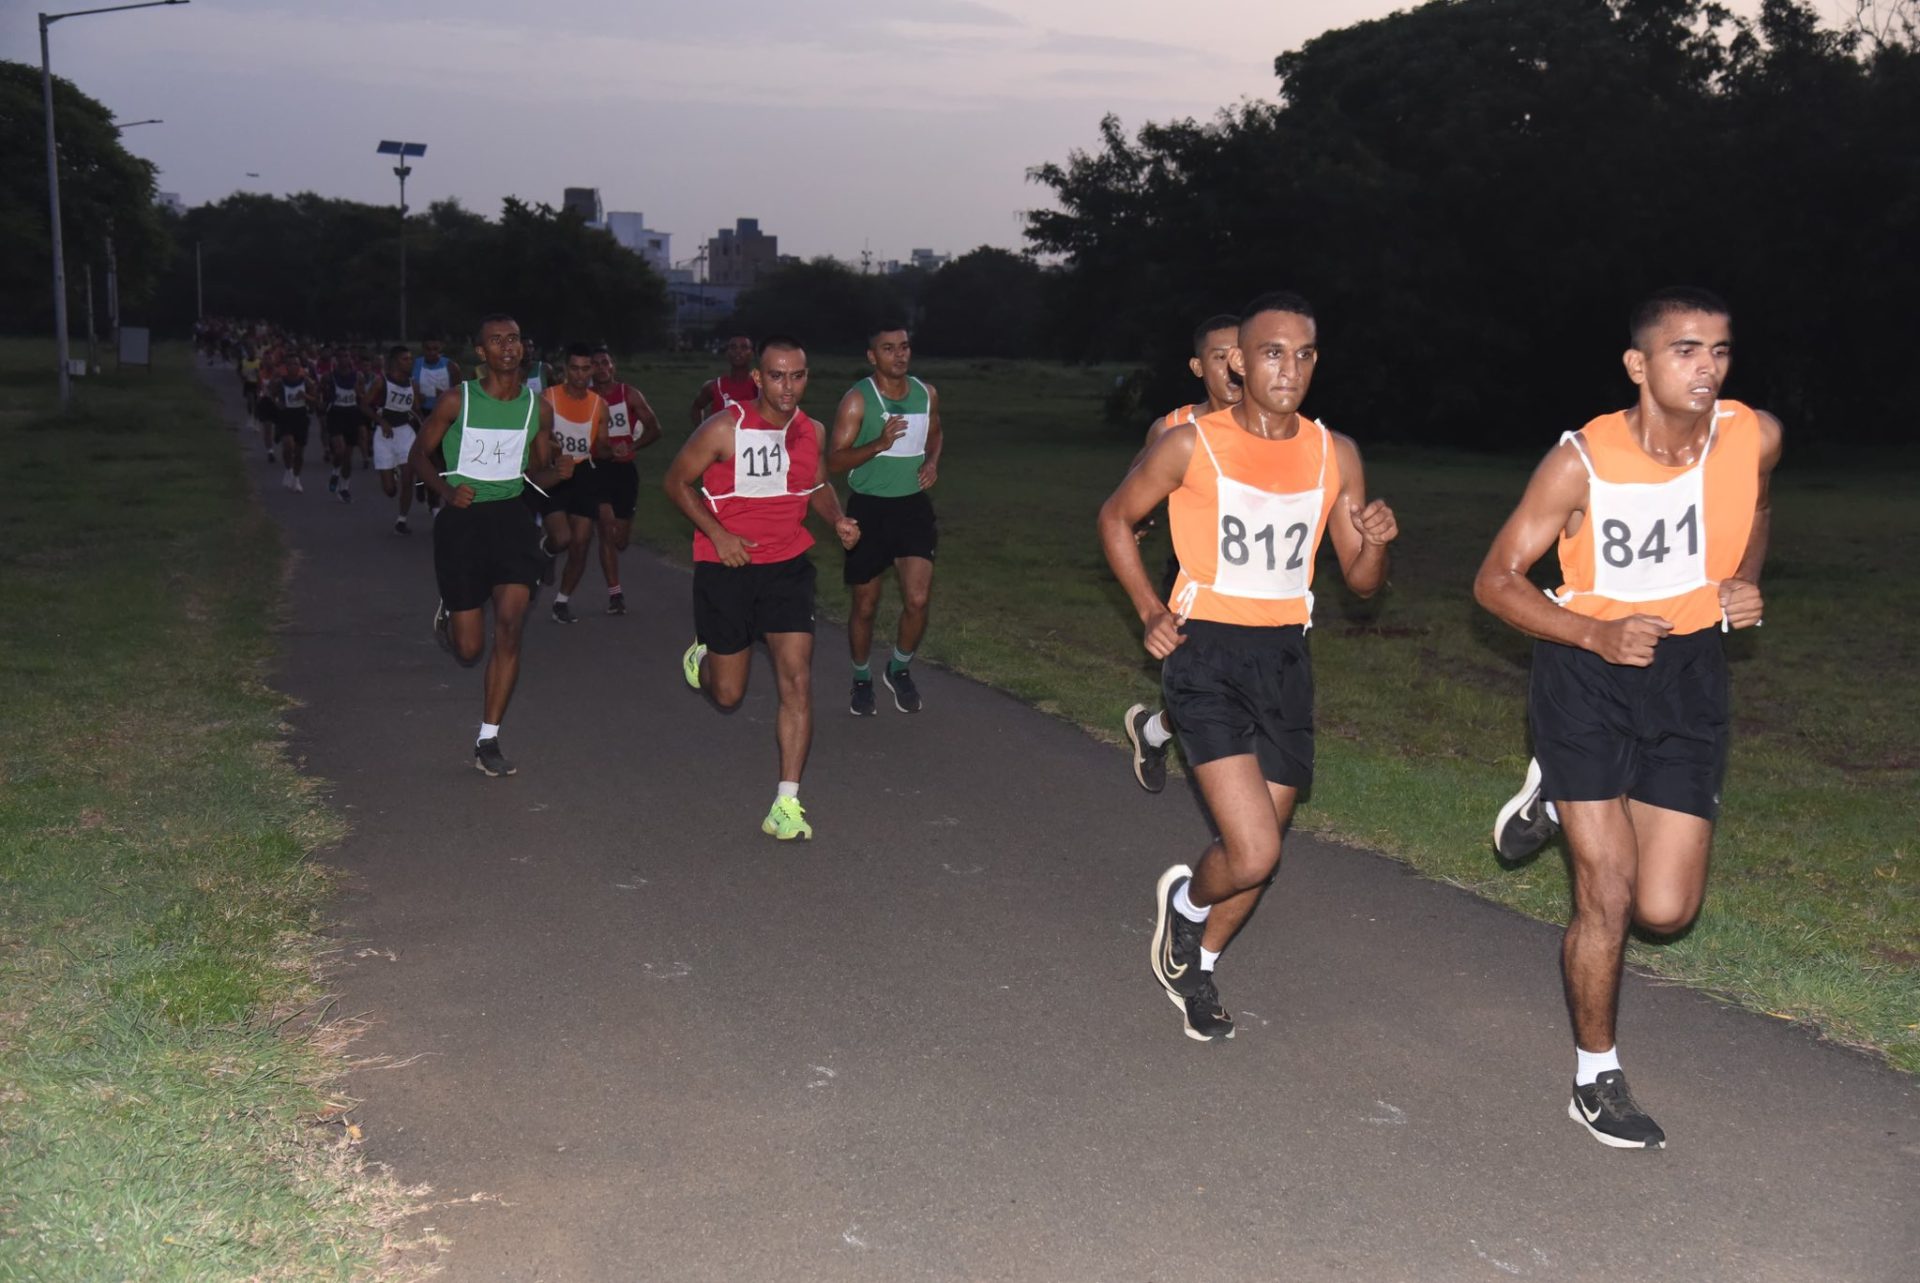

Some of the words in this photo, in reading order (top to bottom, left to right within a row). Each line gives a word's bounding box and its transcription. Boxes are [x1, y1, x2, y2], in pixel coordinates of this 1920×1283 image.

[391, 391, 413, 405] 776
[470, 439, 505, 465] 24
[742, 443, 782, 477] 114
[1220, 514, 1309, 571] 812
[1601, 503, 1699, 568] 841
